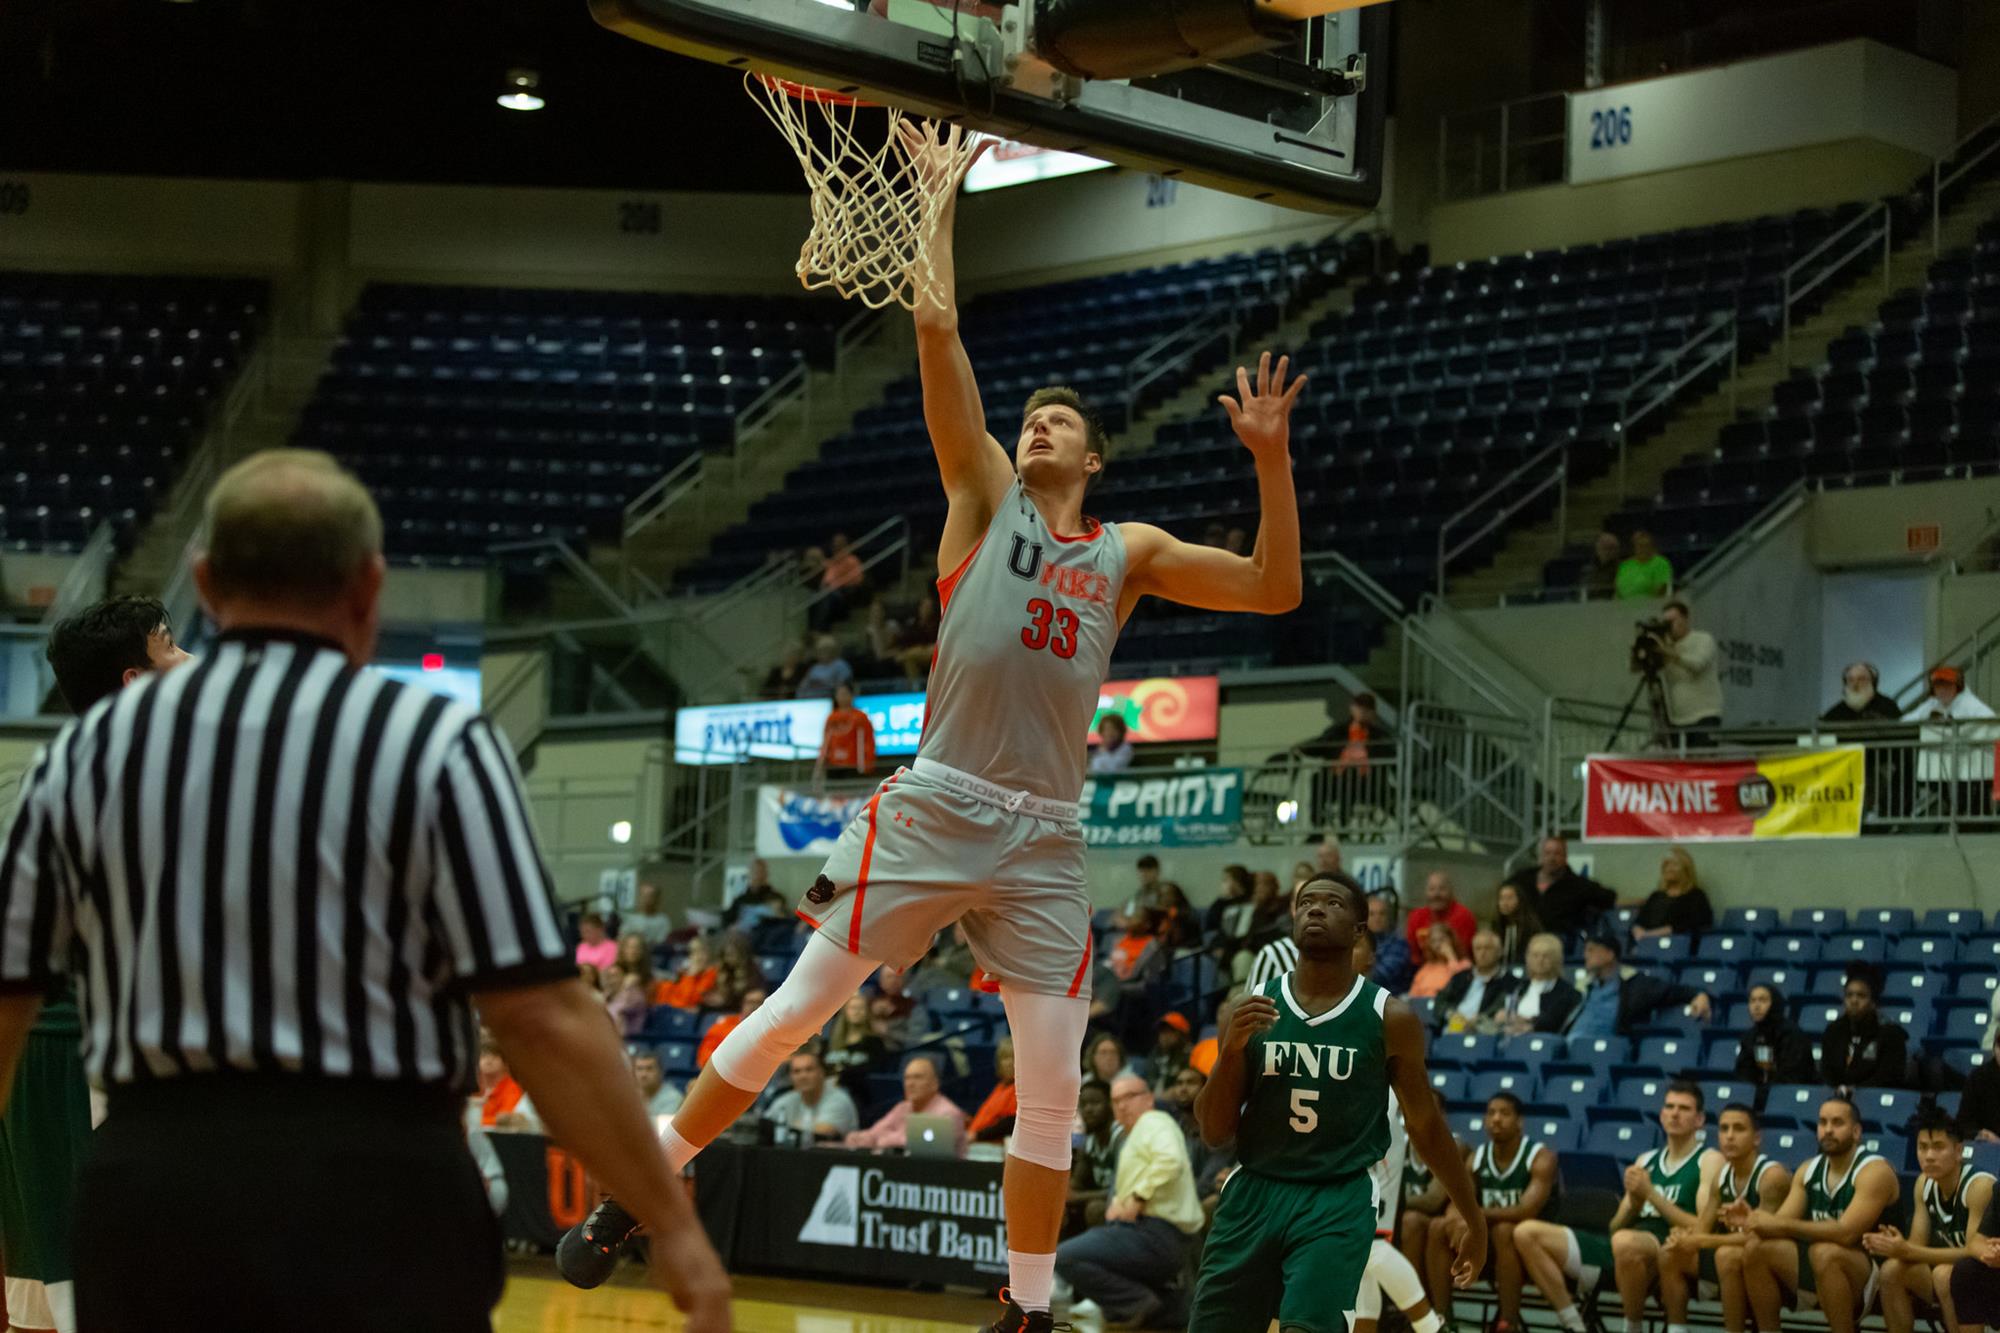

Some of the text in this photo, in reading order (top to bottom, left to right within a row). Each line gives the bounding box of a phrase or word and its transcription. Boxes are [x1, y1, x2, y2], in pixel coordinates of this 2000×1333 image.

[1591, 106, 1632, 148] 206
[1007, 531, 1110, 606] UPIKE
[1021, 598, 1080, 659] 33
[1601, 780, 1720, 815] WHAYNE
[1782, 782, 1854, 804] Rntal
[1262, 1041, 1359, 1081] FNU
[1288, 1087, 1320, 1134] 5
[862, 1168, 1007, 1222] Communit
[860, 1210, 1009, 1265] Trust Bank
